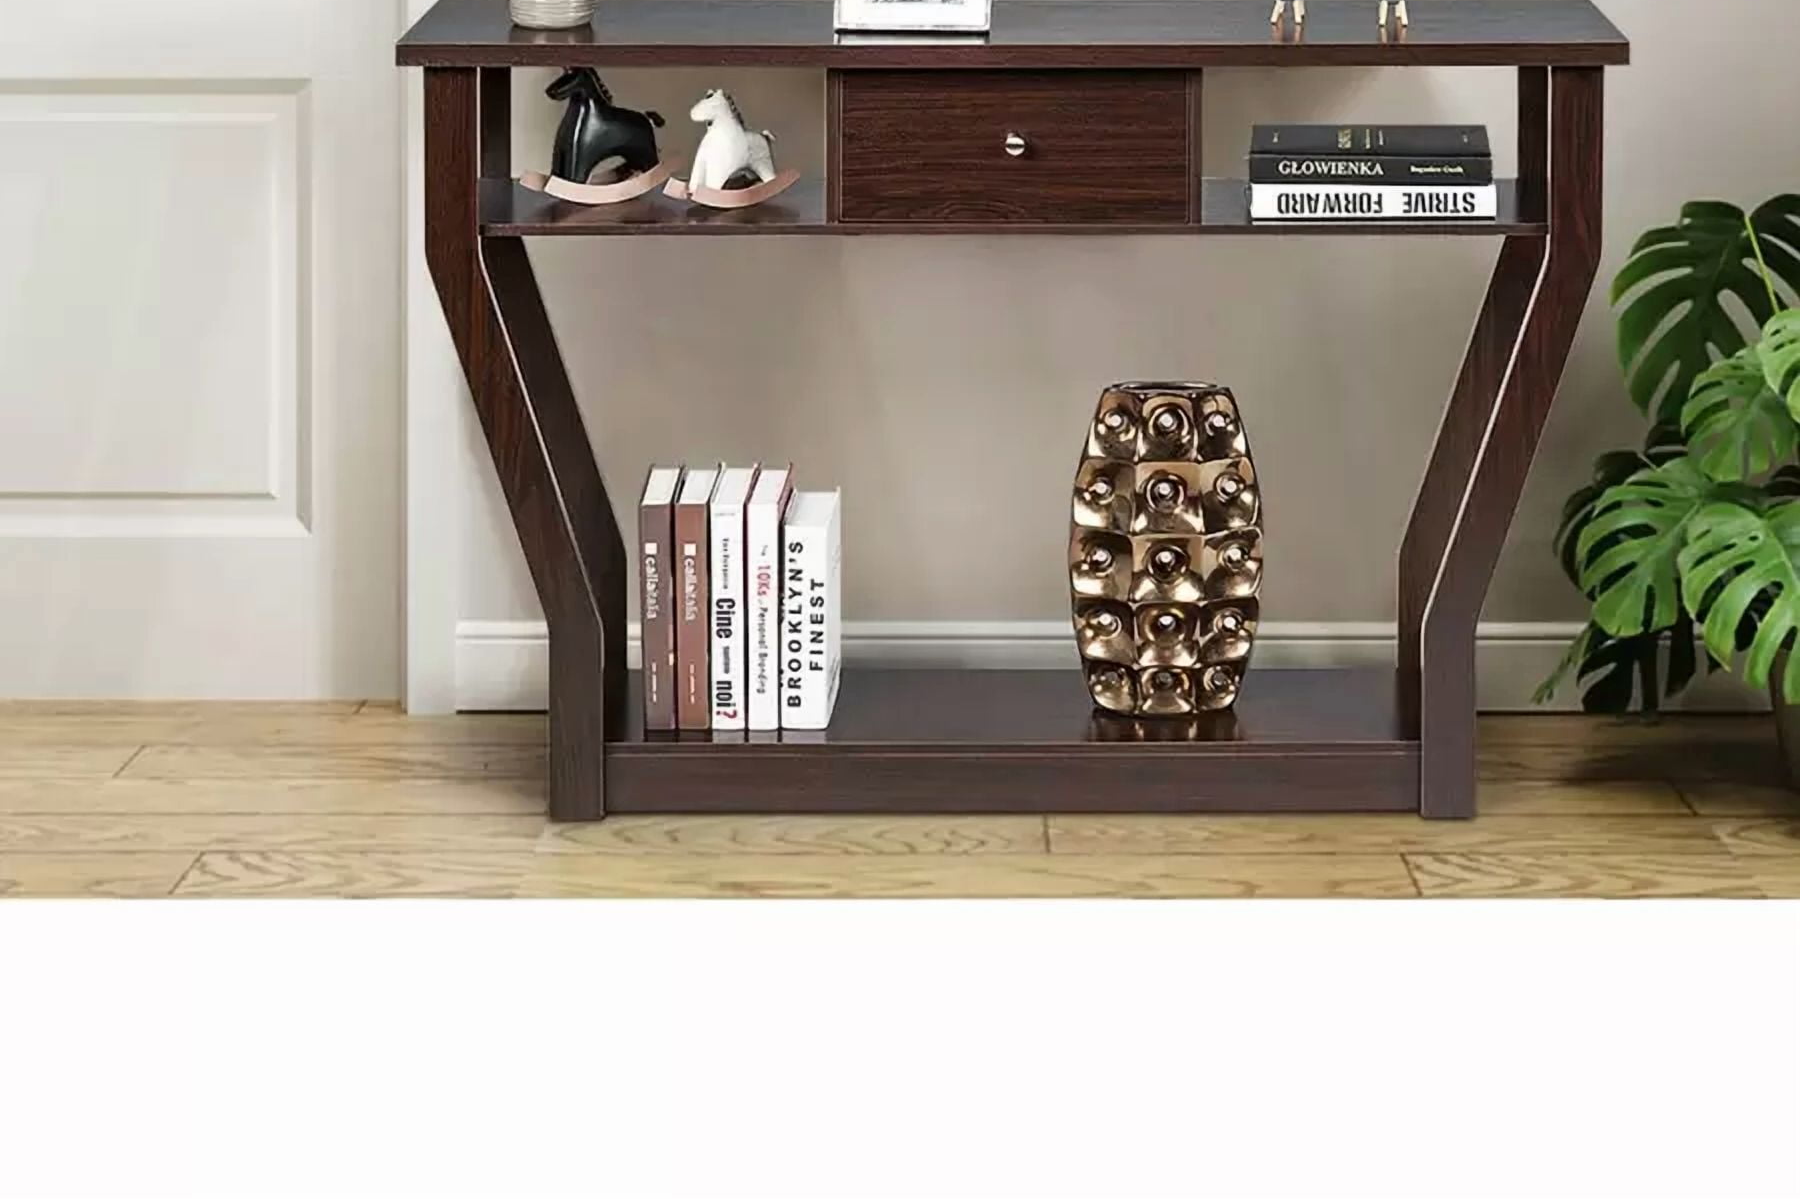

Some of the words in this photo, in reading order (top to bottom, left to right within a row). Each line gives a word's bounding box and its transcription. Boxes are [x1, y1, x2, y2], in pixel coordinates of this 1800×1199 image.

[1276, 192, 1384, 215] FORWARD
[1402, 192, 1475, 215] STRIVE
[715, 597, 736, 639] Cine
[757, 606, 769, 650] Personal
[787, 541, 803, 708] BROOKLYN'S
[809, 578, 825, 671] FINEST
[756, 652, 769, 695] Branding
[715, 680, 738, 719] noi?
